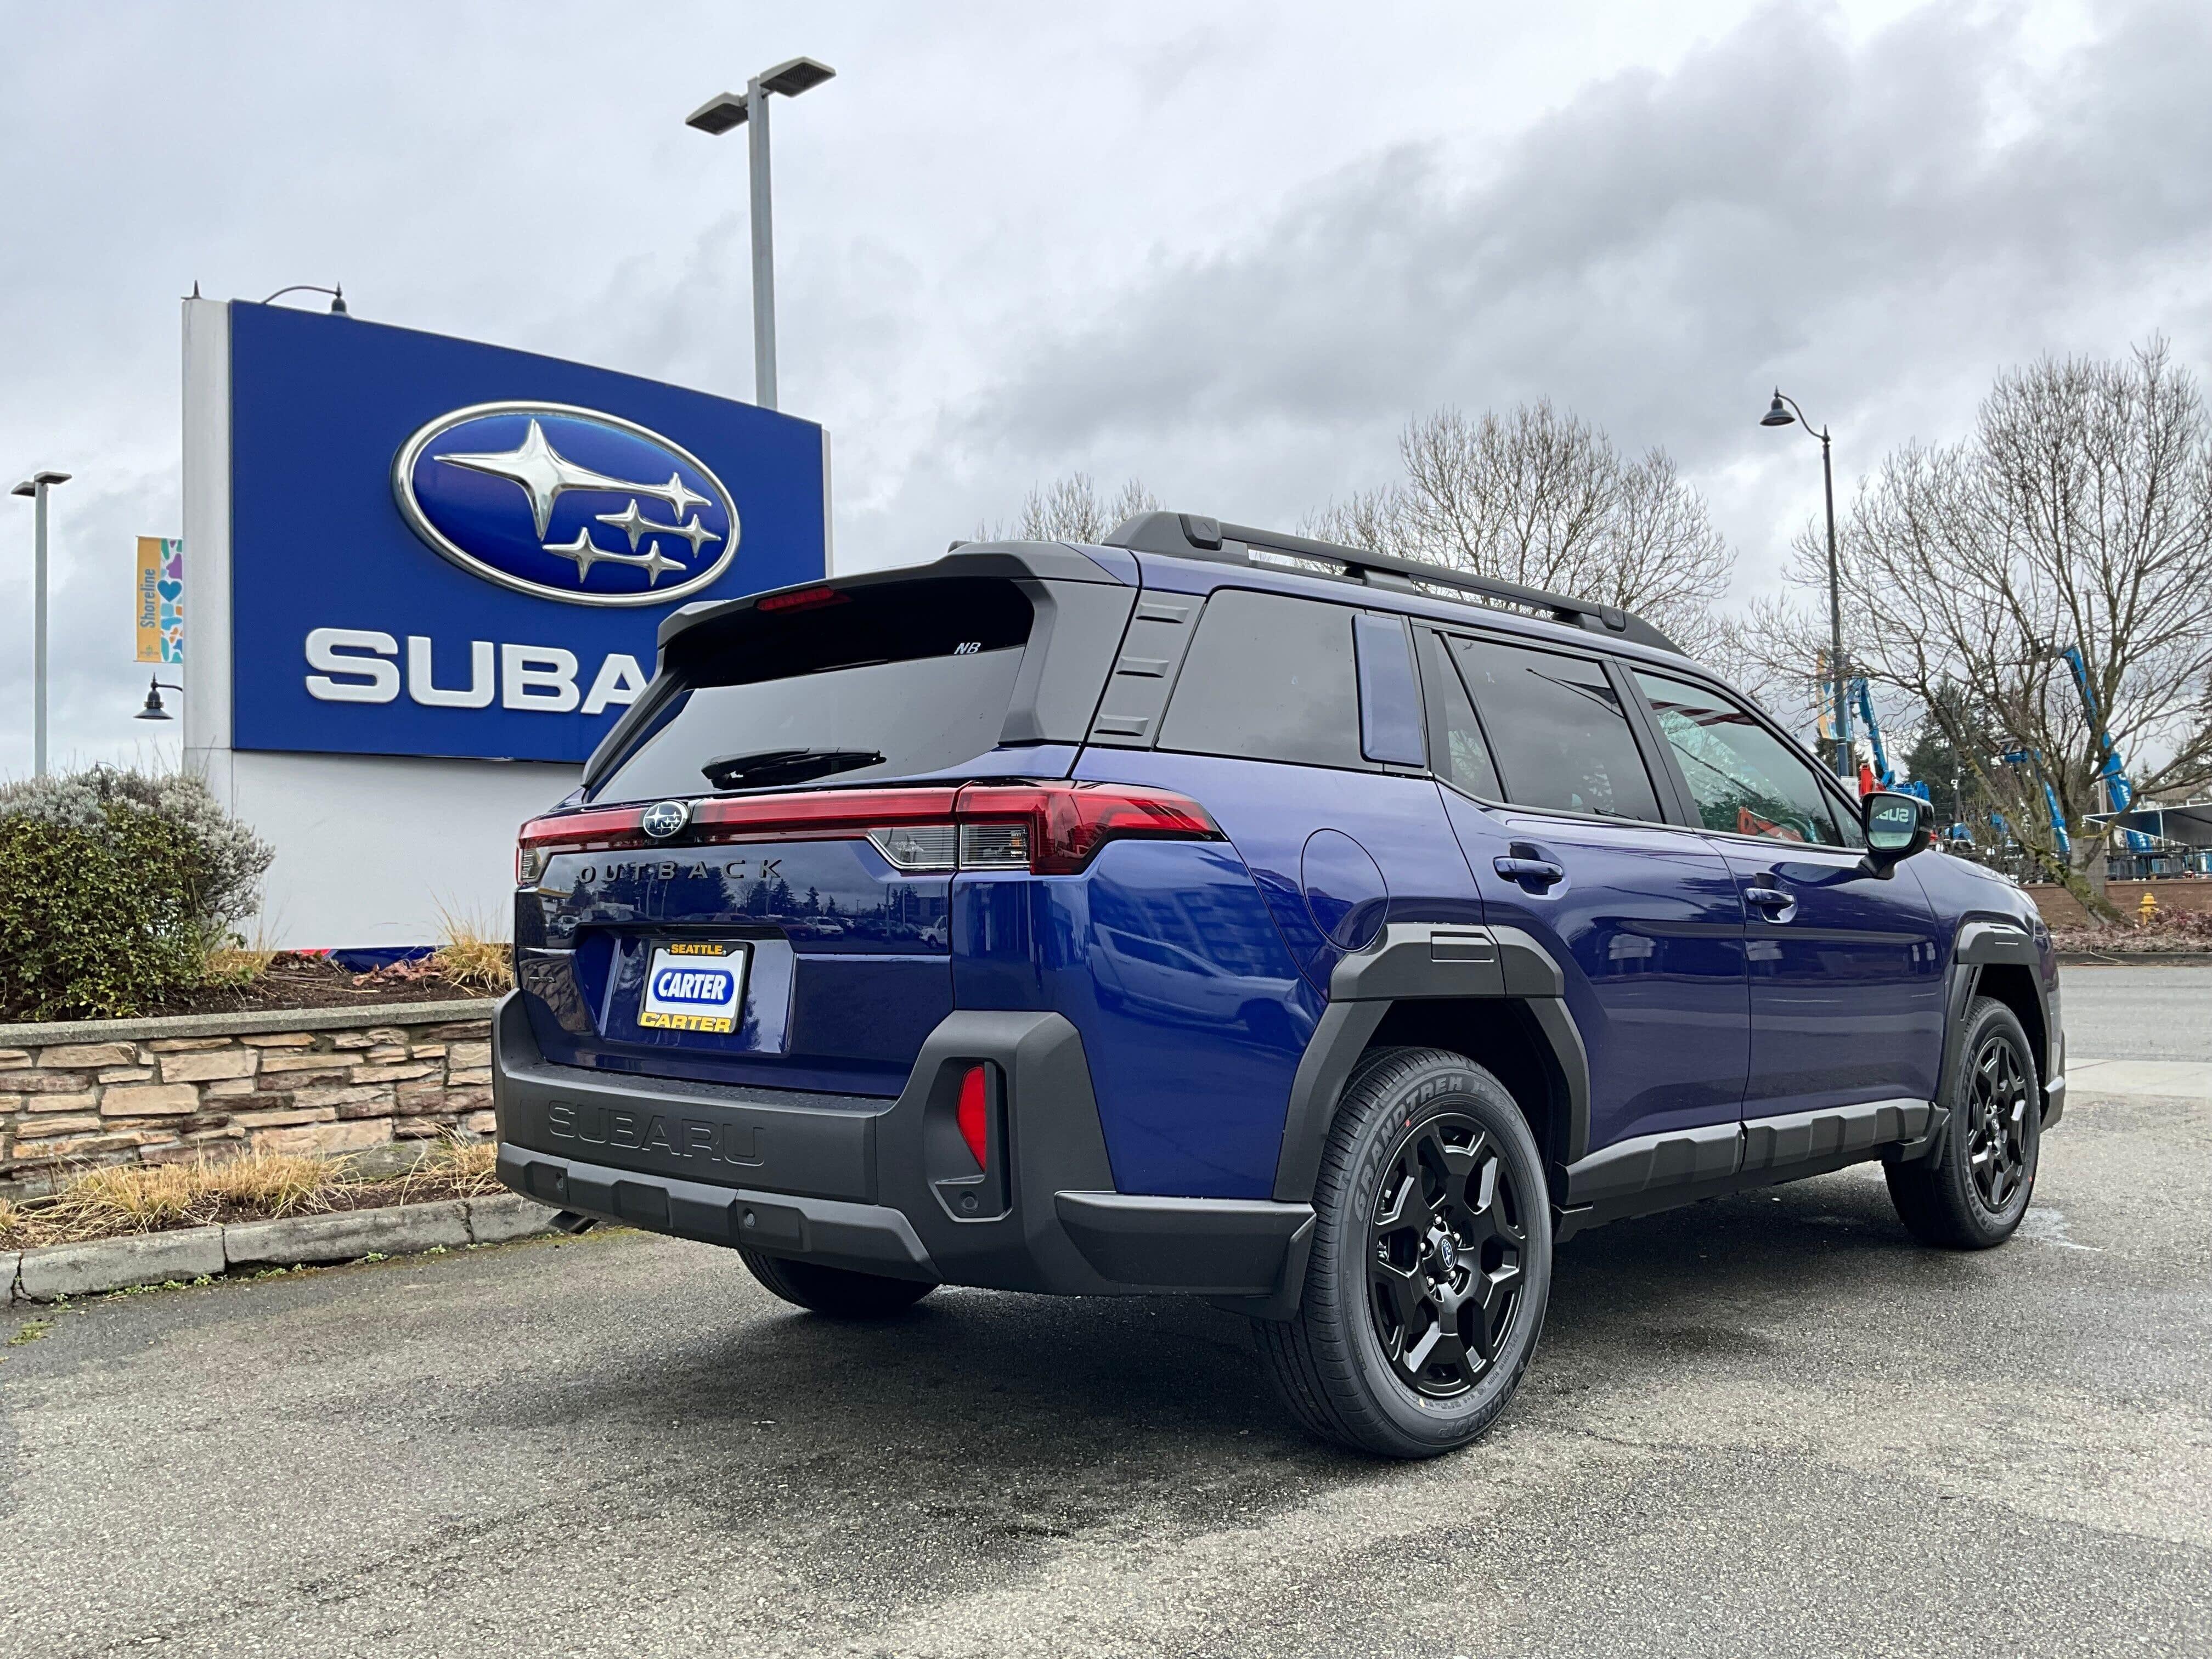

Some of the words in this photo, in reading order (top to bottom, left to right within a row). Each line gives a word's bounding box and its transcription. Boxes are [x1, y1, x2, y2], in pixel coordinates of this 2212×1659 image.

[140, 568, 156, 629] Shoreline
[579, 859, 782, 884] OUTBACK
[671, 944, 723, 955] SEATTLE
[658, 972, 726, 1000] CARTER
[640, 1012, 731, 1033] CARTER
[549, 1100, 764, 1167] SUBARU
[1355, 1076, 1463, 1222] GRANDTREK
[1438, 1376, 1514, 1438] DUNLOP
